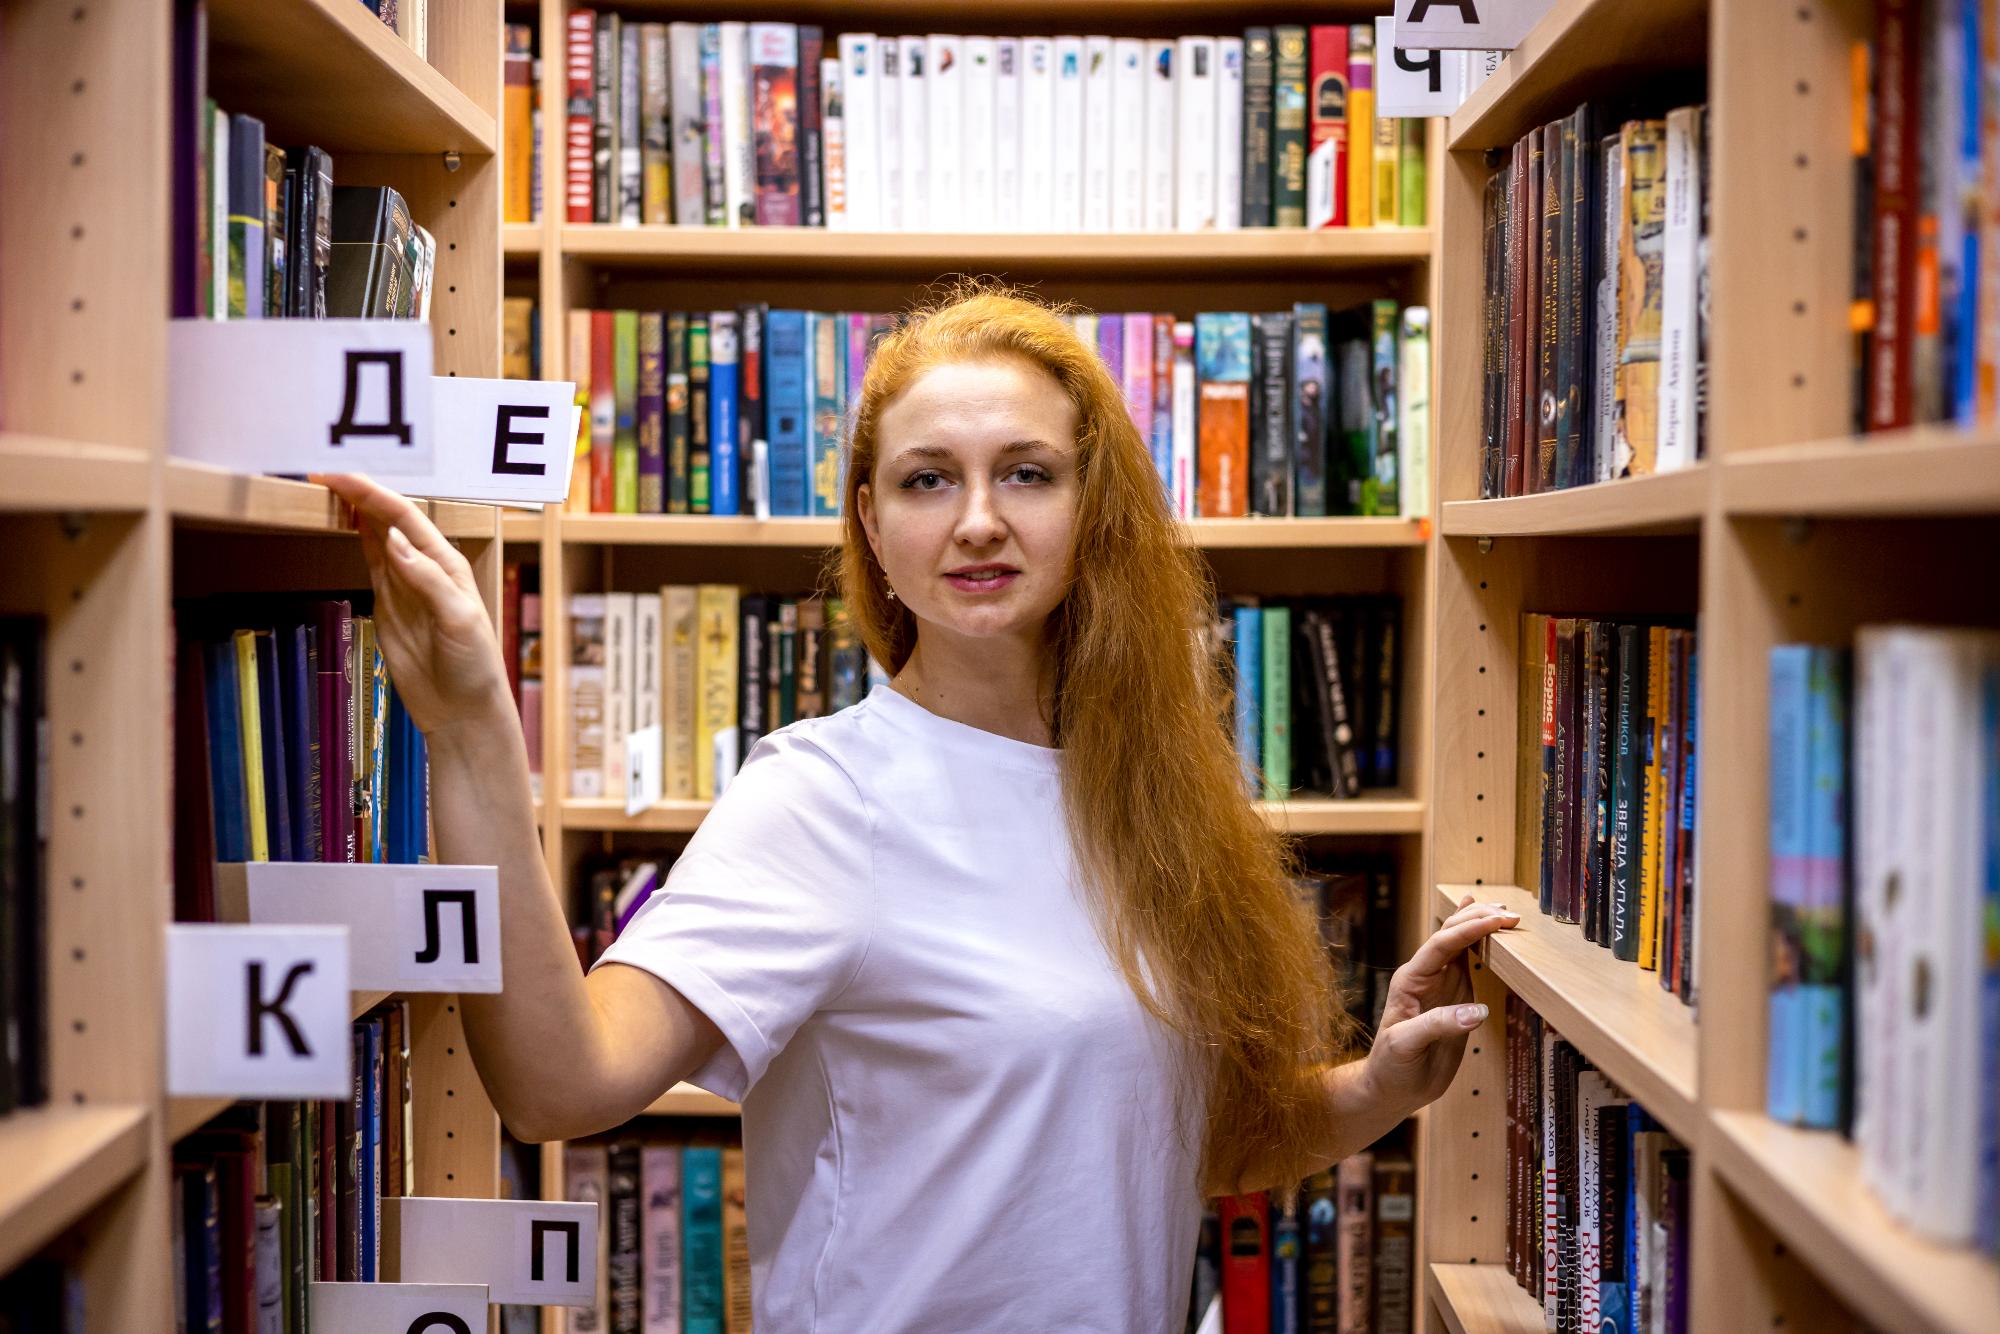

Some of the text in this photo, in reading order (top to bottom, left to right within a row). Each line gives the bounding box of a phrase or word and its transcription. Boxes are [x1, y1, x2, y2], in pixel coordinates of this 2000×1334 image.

[1545, 229, 1553, 265] БОХ
[329, 350, 413, 447] Д
[491, 404, 550, 476] Е
[1545, 663, 1556, 723] Борис
[1620, 671, 1630, 756] АЛЕНИКОВ
[1556, 721, 1566, 861] ДРУГОЙ ПУТЬ
[1614, 799, 1628, 942] ЗВЕЗДА УПАЛА
[414, 889, 480, 965] Л
[245, 960, 316, 1057] К
[1548, 1096, 1556, 1158] АСТАХОВ
[1592, 1107, 1600, 1157] ПАВЕЛ
[1546, 1168, 1560, 1296] ШПИОН
[1592, 1162, 1600, 1229] АСТАХОВ
[530, 1219, 580, 1283] П
